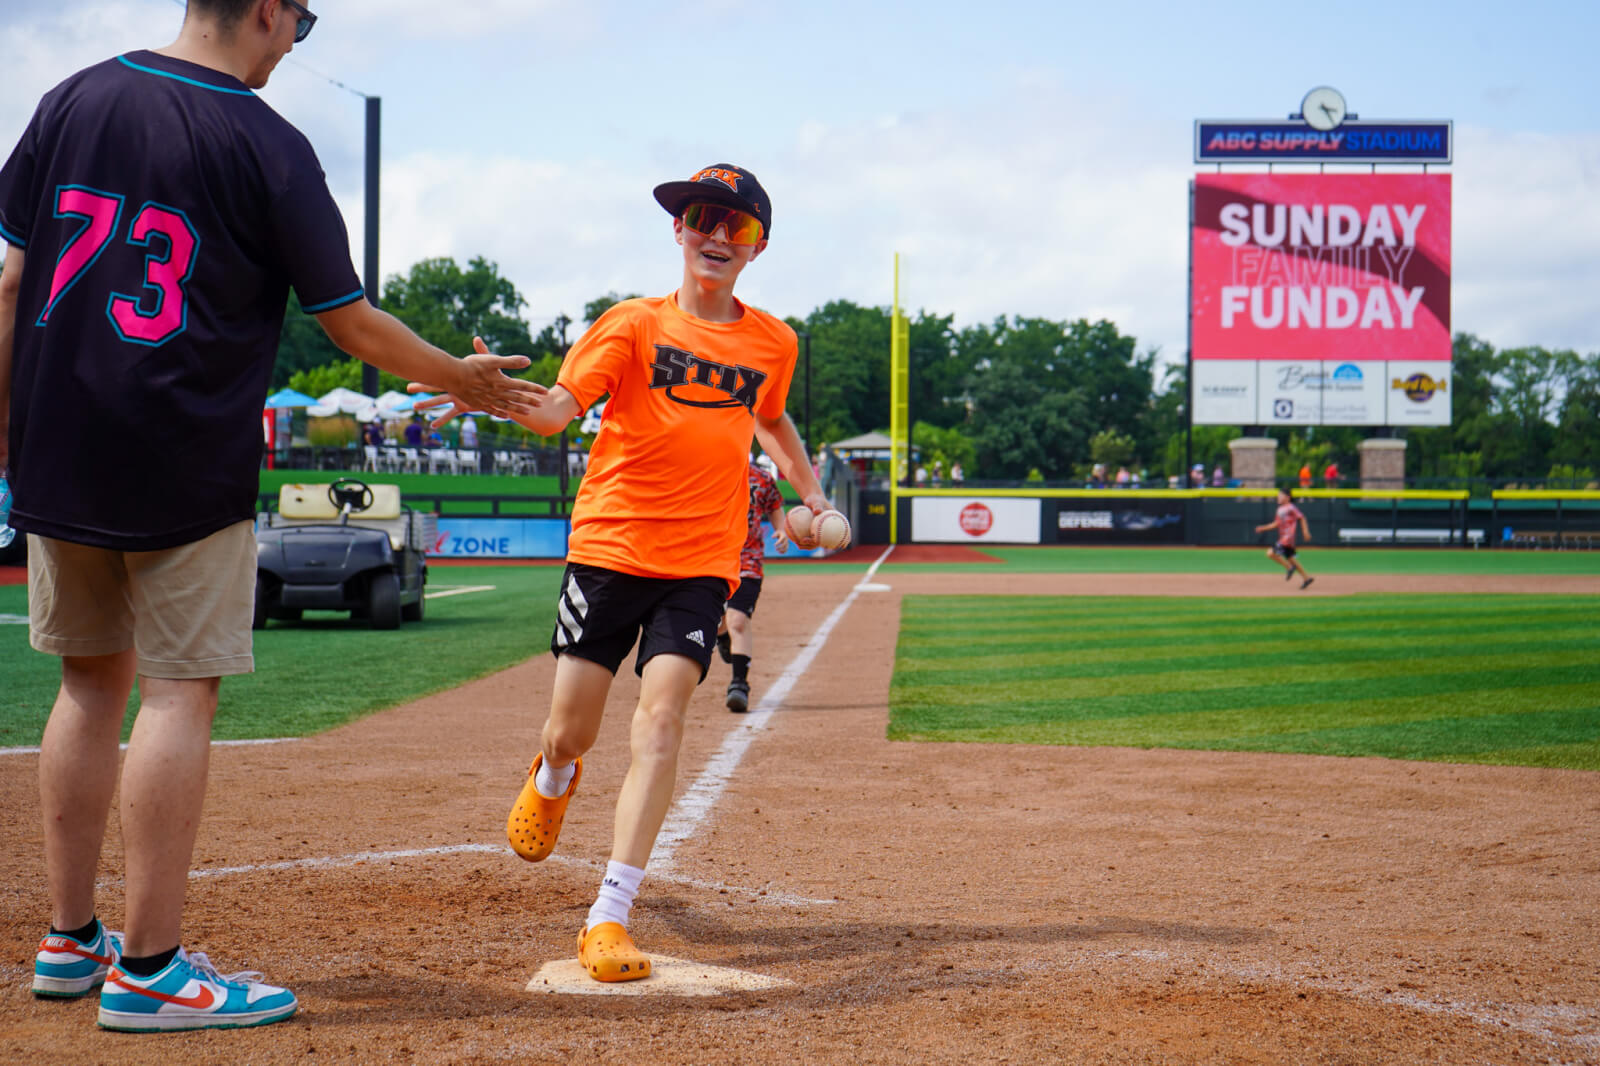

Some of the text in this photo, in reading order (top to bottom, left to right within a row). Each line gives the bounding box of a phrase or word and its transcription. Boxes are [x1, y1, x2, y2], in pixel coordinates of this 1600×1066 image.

[1208, 131, 1441, 150] ABC SUPPLY STADIUM
[1219, 203, 1427, 247] SUNDAY
[35, 184, 201, 348] 73
[1232, 244, 1414, 289] FAMILY
[1220, 286, 1425, 329] FUNDAY
[452, 537, 510, 554] ZONE
[45, 937, 67, 947] NIKE
